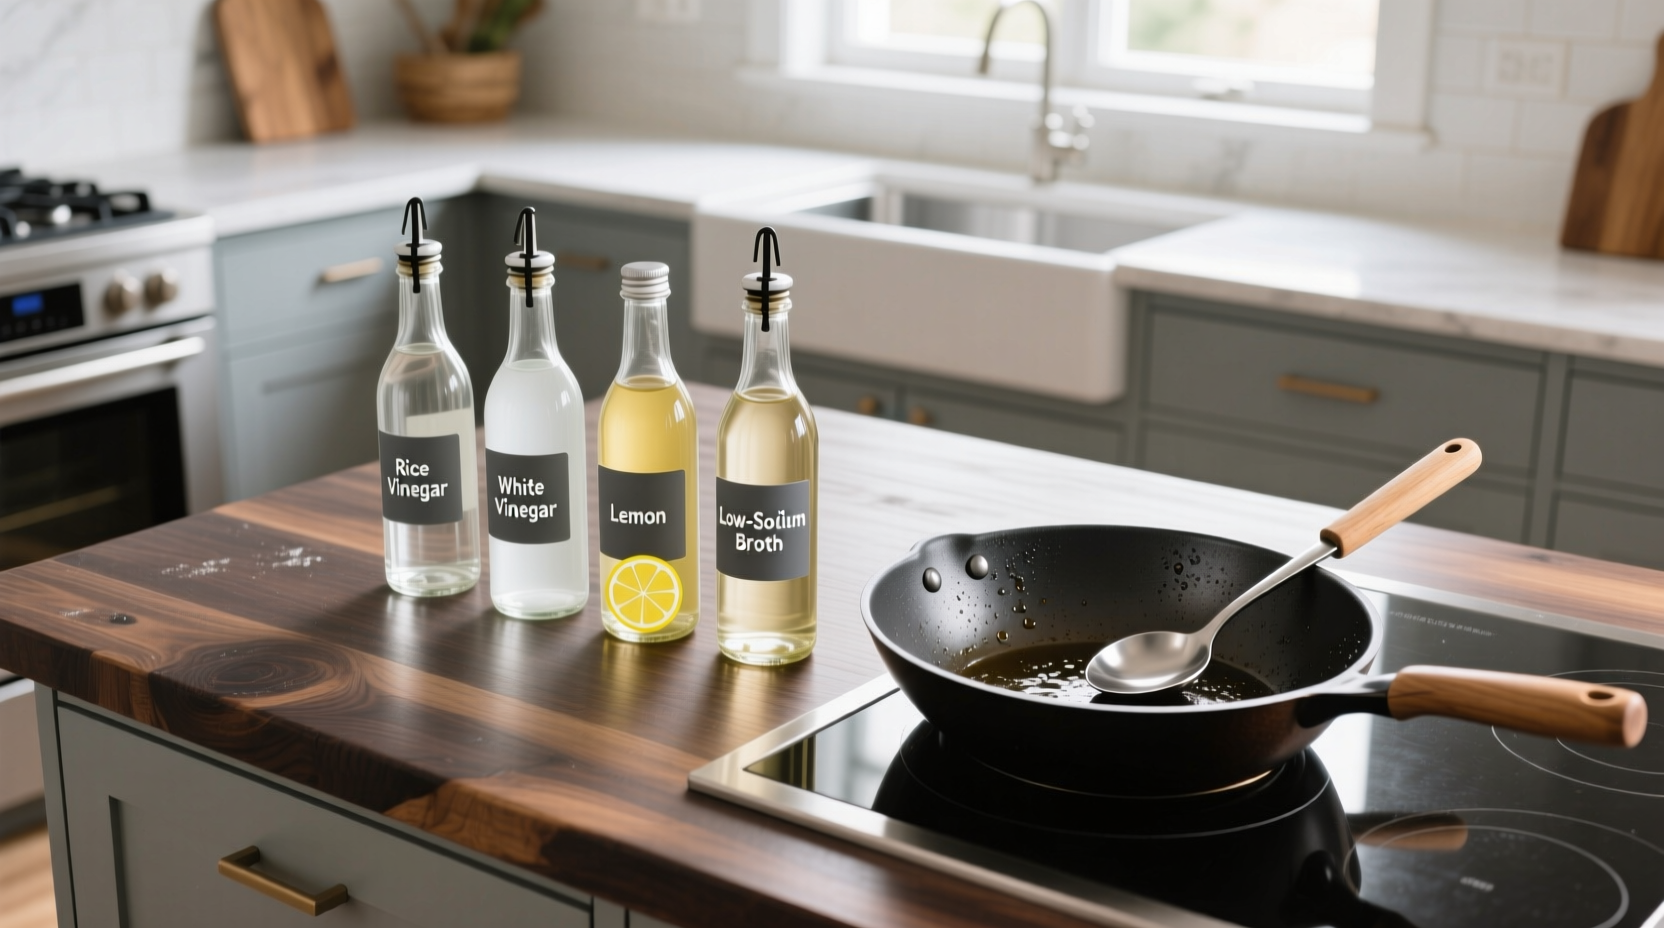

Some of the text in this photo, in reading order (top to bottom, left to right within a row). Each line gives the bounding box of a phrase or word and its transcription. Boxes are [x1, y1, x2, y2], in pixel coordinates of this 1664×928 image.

[395, 458, 430, 477] Rice
[387, 476, 449, 503] Vinegar
[497, 475, 545, 496] White
[494, 496, 558, 523] Vinegar
[610, 502, 667, 525] Lemon
[735, 532, 784, 553] Broth
